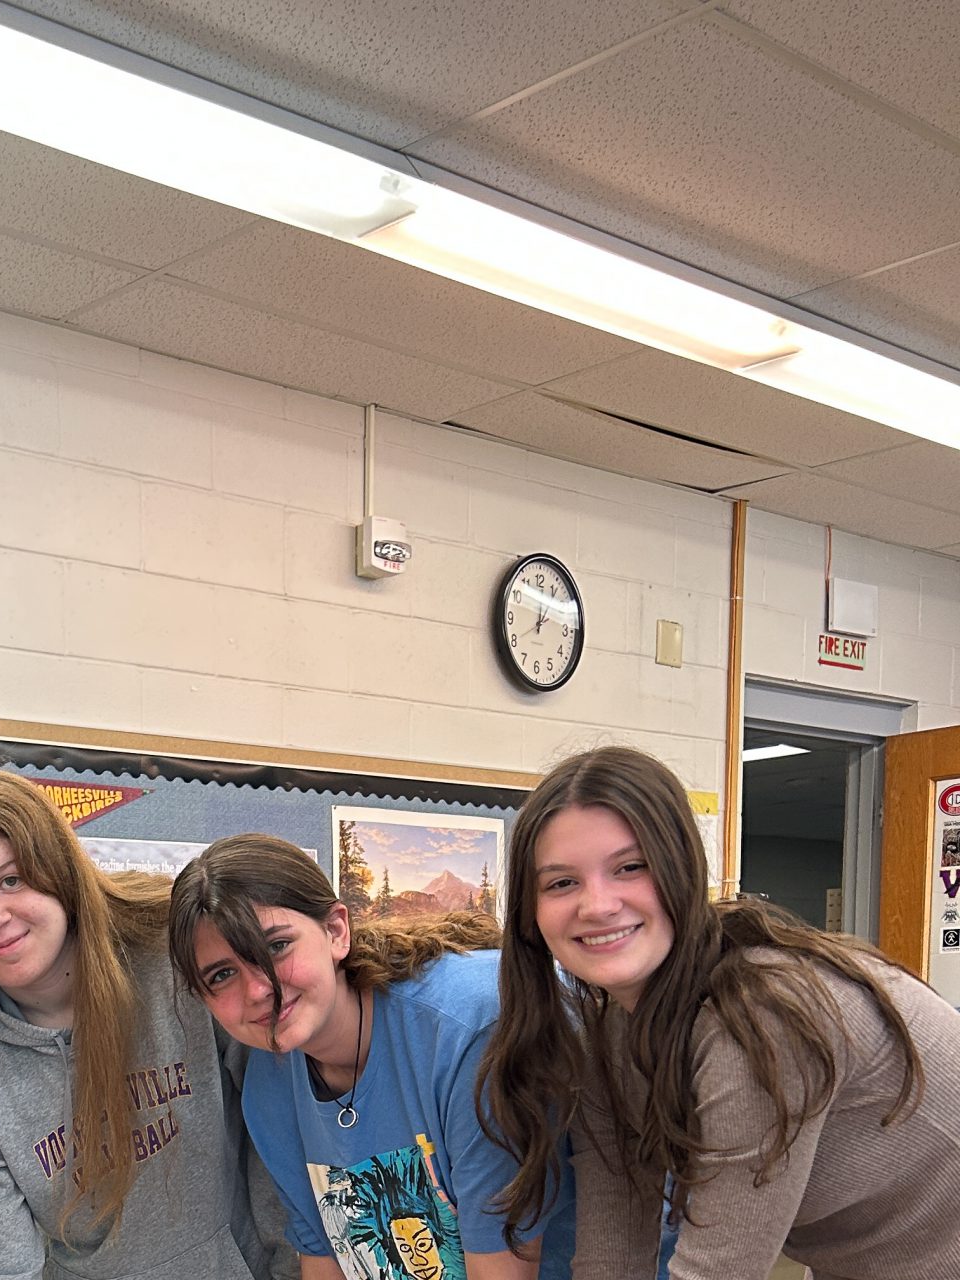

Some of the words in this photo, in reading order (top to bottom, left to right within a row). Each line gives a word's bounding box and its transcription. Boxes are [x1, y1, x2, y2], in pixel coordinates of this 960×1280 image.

[535, 574, 544, 588] 12
[512, 589, 521, 604] 10
[507, 611, 513, 625] 9
[562, 624, 568, 637] 3
[511, 634, 517, 647] 8
[819, 635, 840, 656] FIRE
[843, 639, 866, 660] EXIT
[557, 645, 563, 657] 4
[521, 652, 528, 666] 7
[547, 658, 553, 671] 5
[534, 661, 540, 674] 6
[38, 784, 123, 805] ORHEESVILLE
[62, 795, 123, 824] CKBIRDS
[162, 860, 175, 872] the
